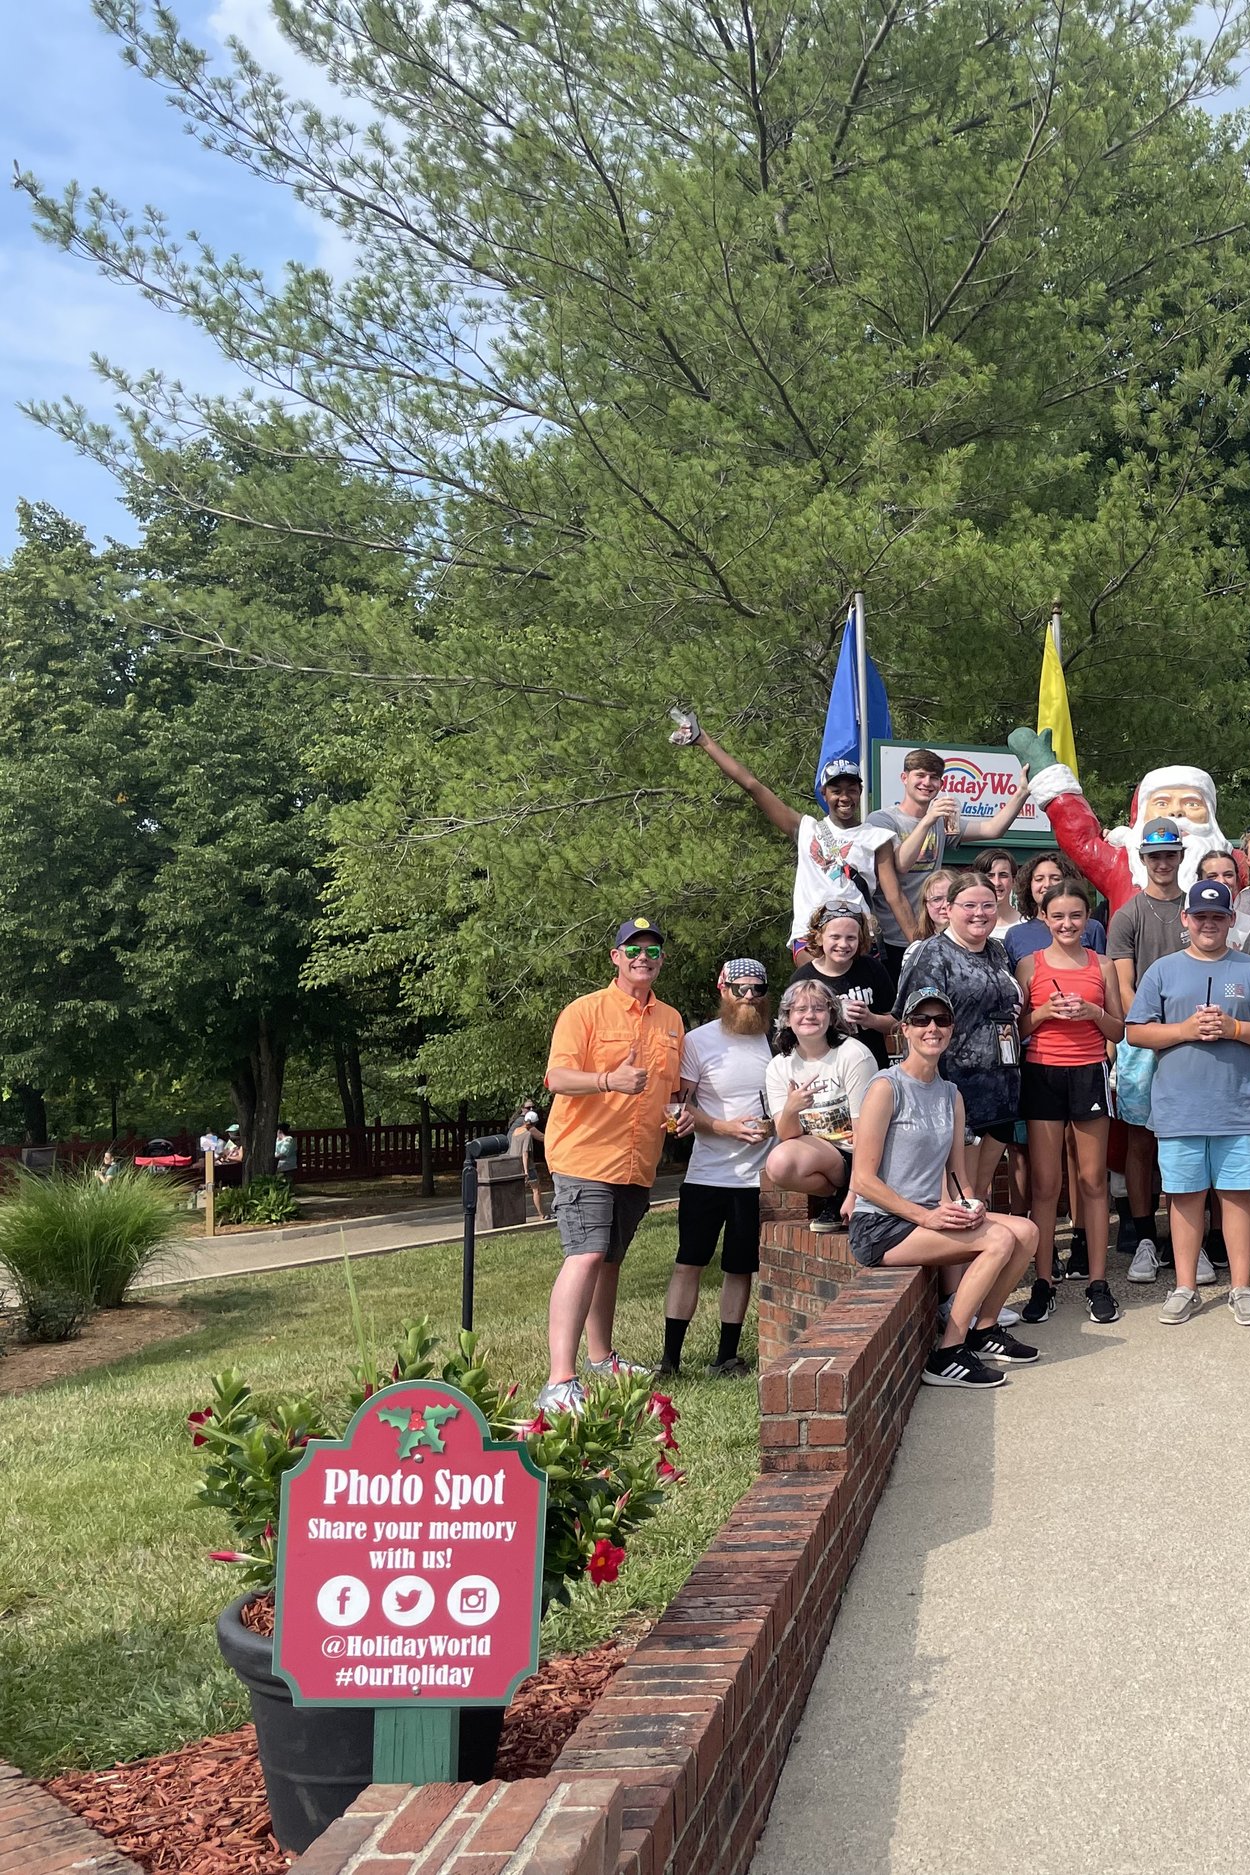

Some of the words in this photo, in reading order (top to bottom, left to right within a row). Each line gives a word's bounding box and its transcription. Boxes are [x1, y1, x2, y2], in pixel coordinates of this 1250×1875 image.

[941, 775, 988, 802] liday
[323, 1469, 423, 1506] Photo
[434, 1469, 506, 1510] Spot
[308, 1518, 368, 1541] Share
[373, 1521, 424, 1541] your
[428, 1519, 518, 1542] memory
[369, 1547, 416, 1569] with
[422, 1547, 453, 1569] us!
[321, 1635, 491, 1659] @HolidayWorld
[335, 1664, 474, 1688] #OurHoliday
